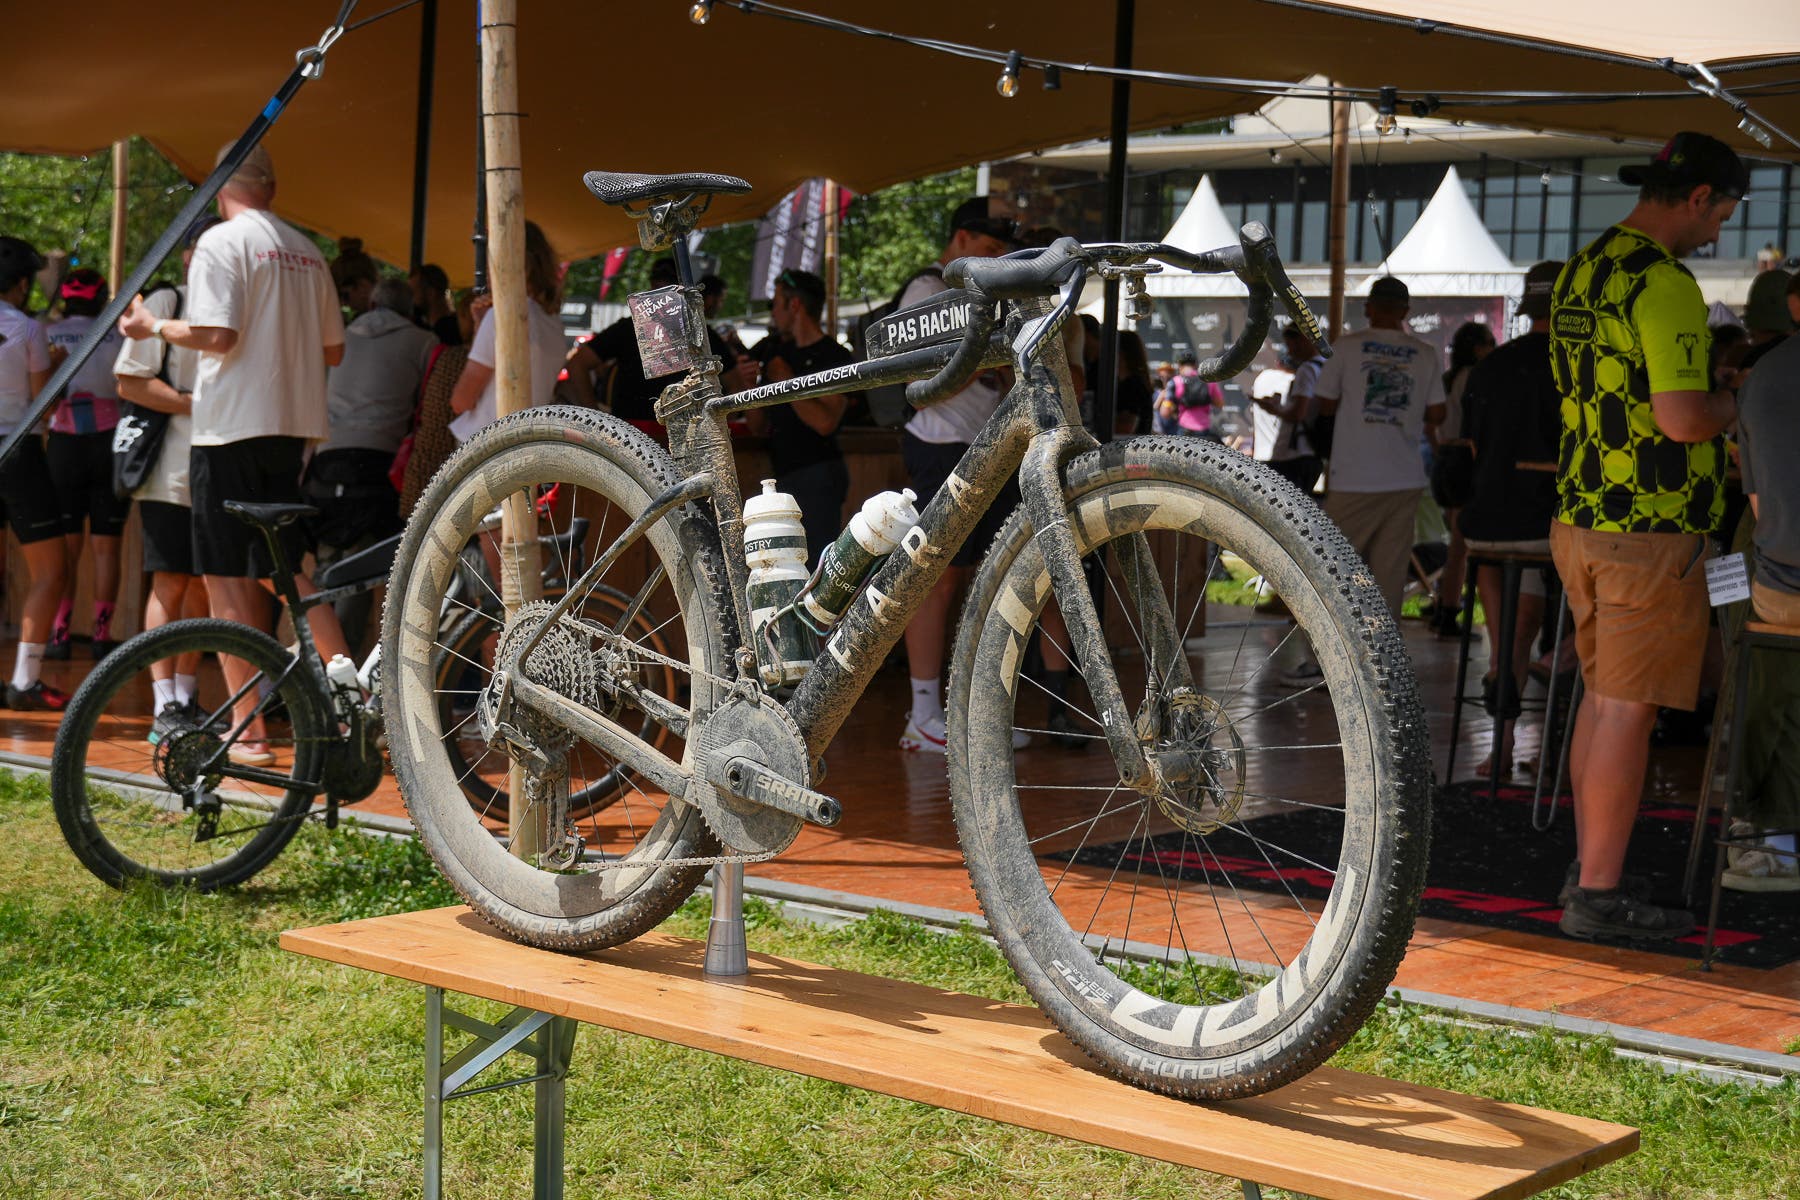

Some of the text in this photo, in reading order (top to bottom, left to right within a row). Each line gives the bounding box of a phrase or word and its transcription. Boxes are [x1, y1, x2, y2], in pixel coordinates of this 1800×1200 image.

[635, 297, 654, 313] THE
[640, 295, 674, 320] TRAKA
[1286, 285, 1322, 339] SRAM
[654, 324, 664, 342] 4
[887, 318, 917, 346] PAS
[734, 364, 859, 405] NORDAHL SVENDSEN
[825, 562, 857, 593] NATURE
[756, 774, 825, 810] SRAM
[1124, 999, 1328, 1080] THUNDER BURT
